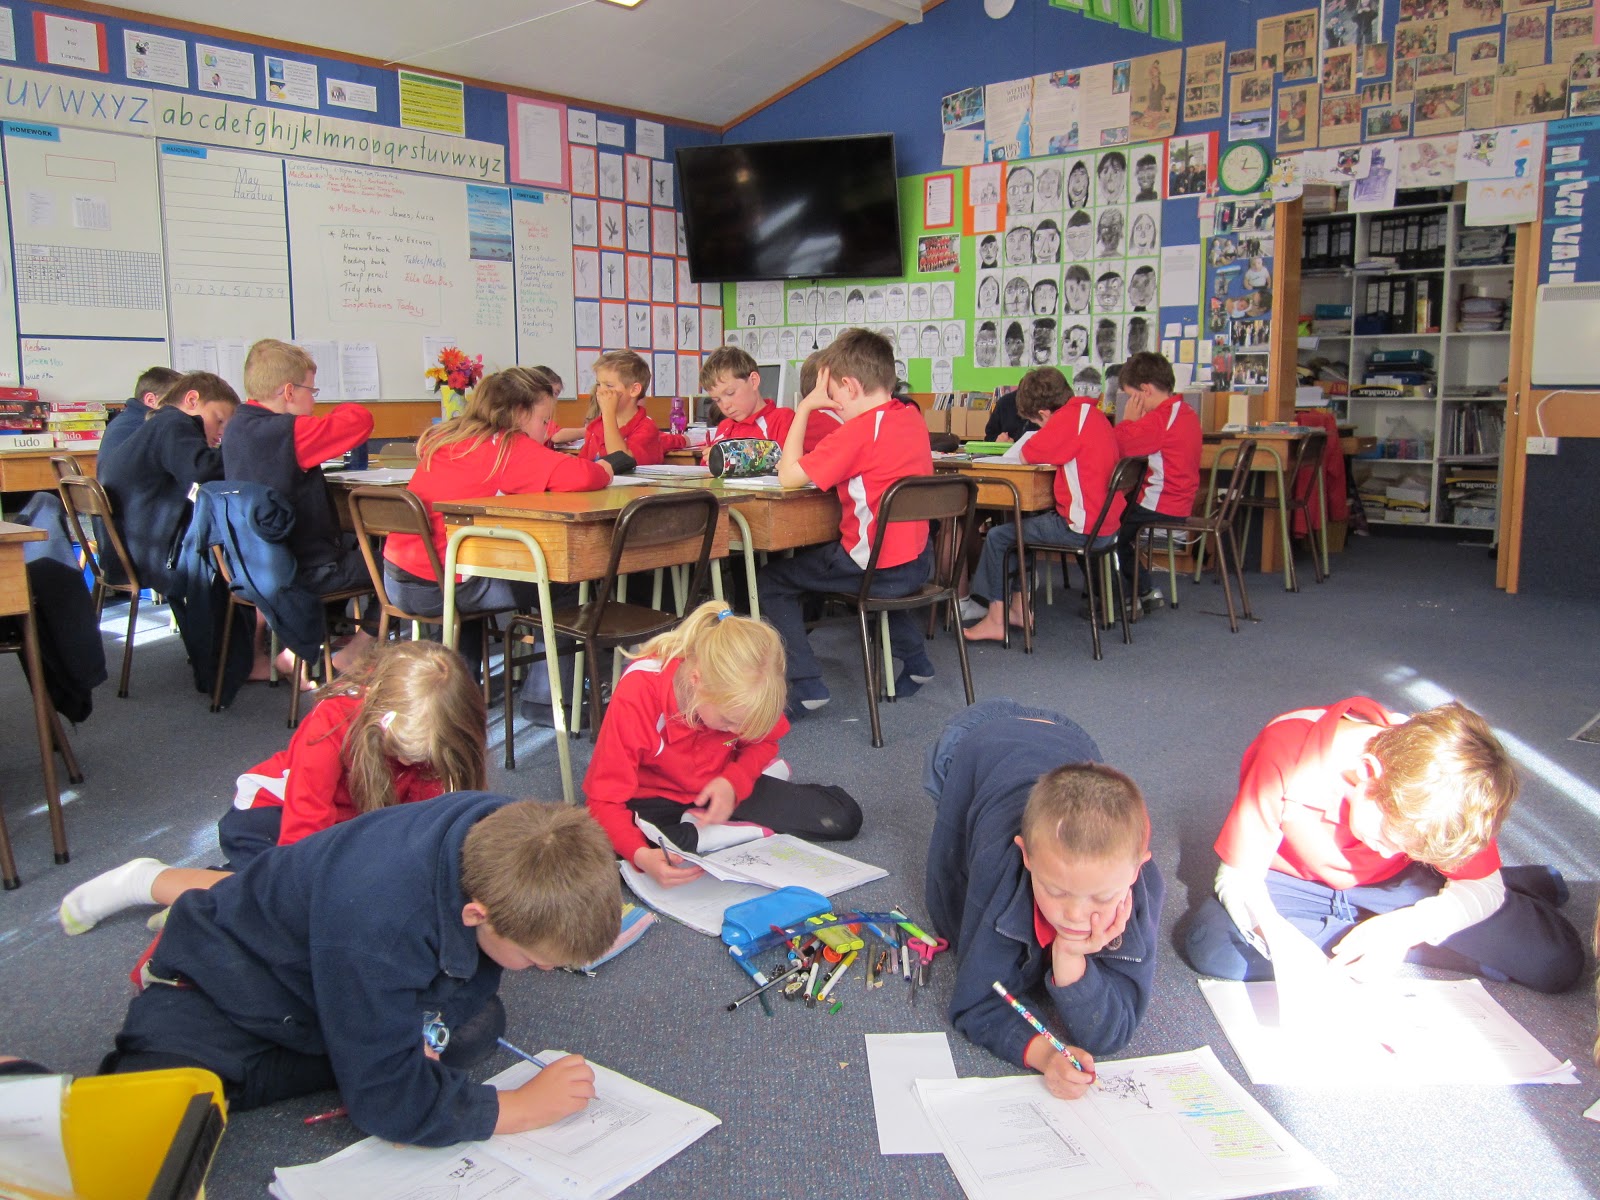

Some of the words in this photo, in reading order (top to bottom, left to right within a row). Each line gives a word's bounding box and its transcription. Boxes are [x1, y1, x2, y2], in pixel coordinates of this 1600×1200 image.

[64, 25, 78, 33] Keys
[61, 52, 87, 63] Learning
[9, 126, 52, 137] HOMEWORK
[166, 146, 200, 155] HANDWRITING
[236, 167, 260, 192] May
[233, 183, 273, 201] Haratua
[337, 203, 366, 214] MacBook
[369, 207, 381, 215] Air
[340, 228, 361, 239] Before
[394, 235, 403, 243] No
[406, 237, 432, 246] Excuses
[343, 243, 373, 251] Homework
[375, 245, 391, 253] book
[343, 255, 366, 272] Reading
[371, 257, 386, 266] book
[343, 270, 363, 282] Sharp
[340, 281, 361, 302] Tidy
[364, 285, 383, 294] desk
[342, 298, 393, 312] Inspections
[1359, 389, 1400, 397] OfficeMax
[13, 437, 40, 448] Ludo
